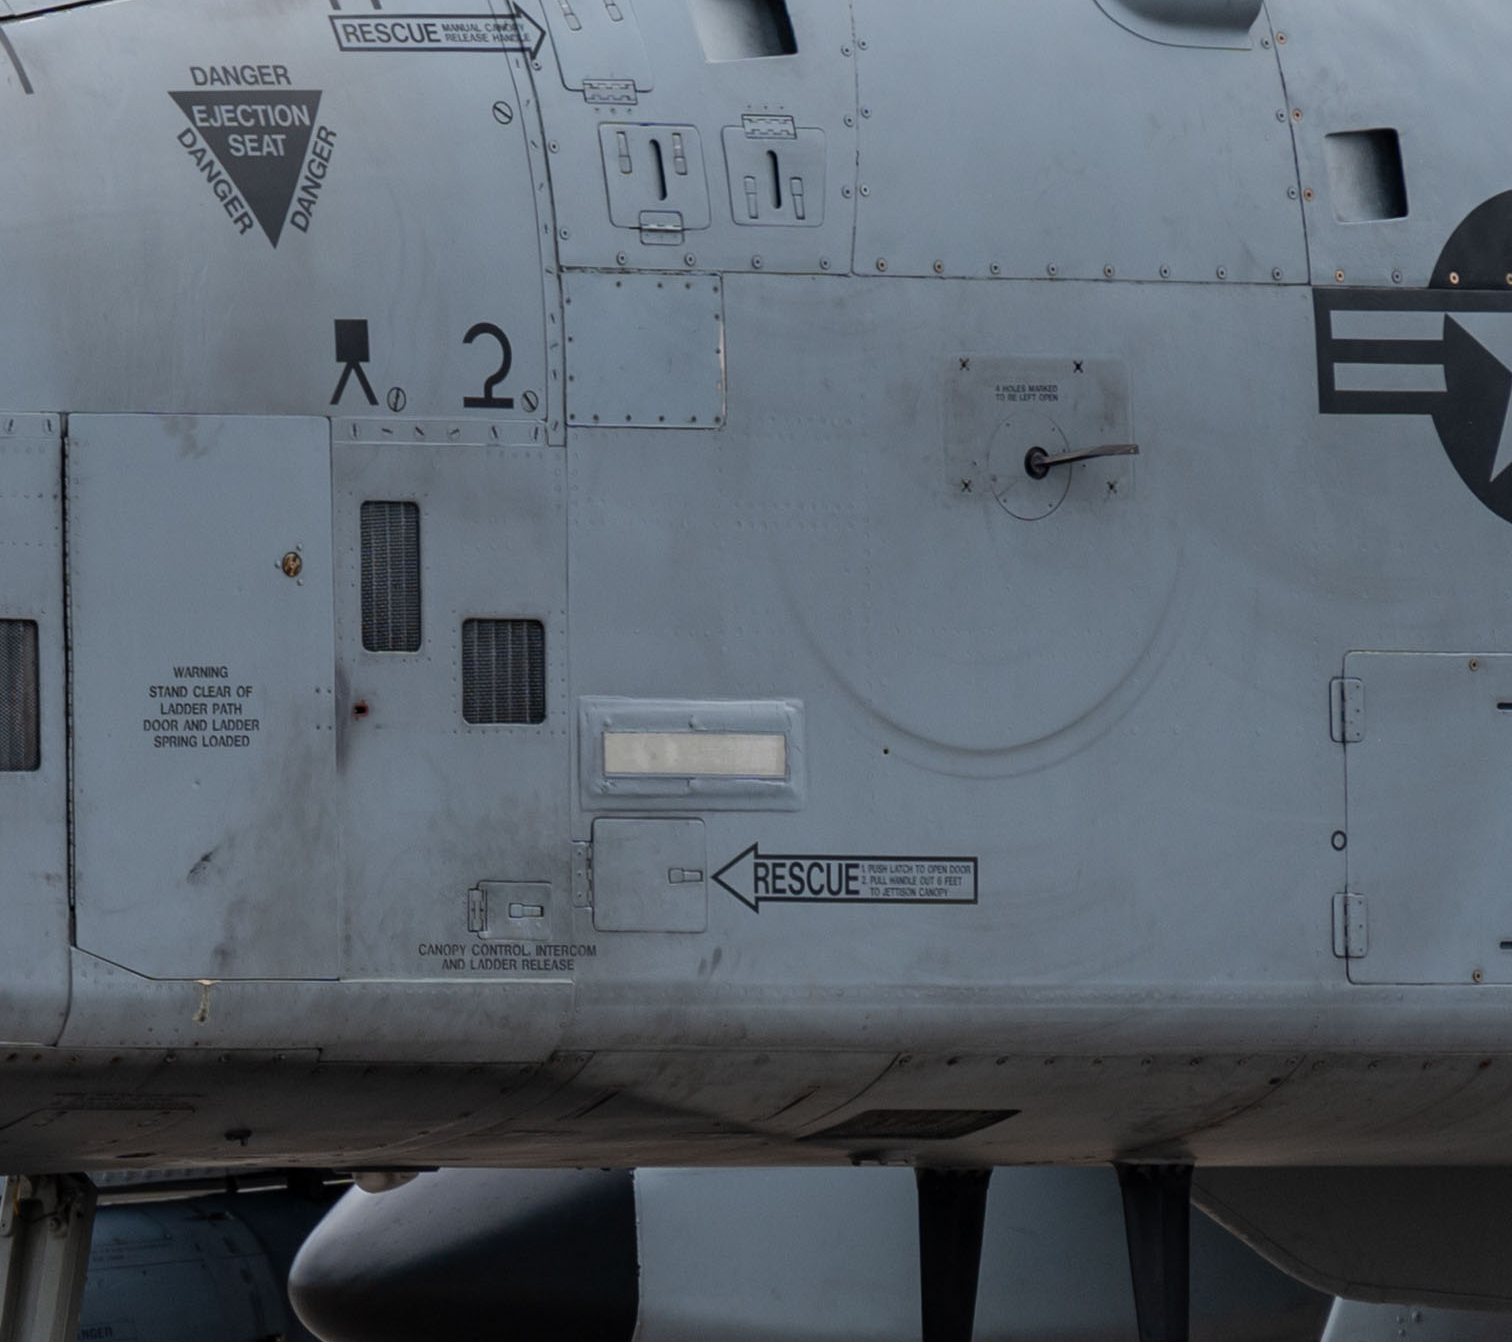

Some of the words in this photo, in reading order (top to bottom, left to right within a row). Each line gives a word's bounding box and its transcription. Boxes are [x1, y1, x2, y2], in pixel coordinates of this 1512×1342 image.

[342, 23, 441, 44] RESCUE
[441, 23, 482, 32] MANUAL
[445, 33, 489, 42] RELEASE
[189, 65, 292, 86] DANGER
[192, 104, 311, 127] EJECTION
[228, 134, 287, 157] SEAT
[177, 127, 254, 235] DANGER
[289, 125, 337, 233] DANGER
[173, 666, 228, 679] WARNING
[149, 685, 188, 698] STAND
[193, 685, 231, 698] CLEAR
[236, 685, 253, 698] OF
[160, 703, 207, 715] LADDER
[212, 703, 242, 715] PATH
[143, 719, 178, 731] DOOR
[184, 719, 207, 731] AND
[212, 719, 260, 731] LADDER
[154, 735, 197, 748] SPRING
[202, 735, 250, 747] LOADED
[889, 865, 914, 874] LATCH
[916, 865, 926, 874] TO
[928, 865, 948, 874] OPEN
[949, 865, 972, 874] DOOR
[754, 861, 860, 896] RESCUE
[870, 876, 888, 885] PULL
[944, 877, 963, 886] FEET
[870, 887, 881, 896] TO
[418, 943, 466, 956] CANOPY
[535, 944, 597, 957] INTERCOM
[442, 958, 465, 970] AND
[470, 958, 517, 971] LADDER
[522, 959, 574, 971] RELEASE
